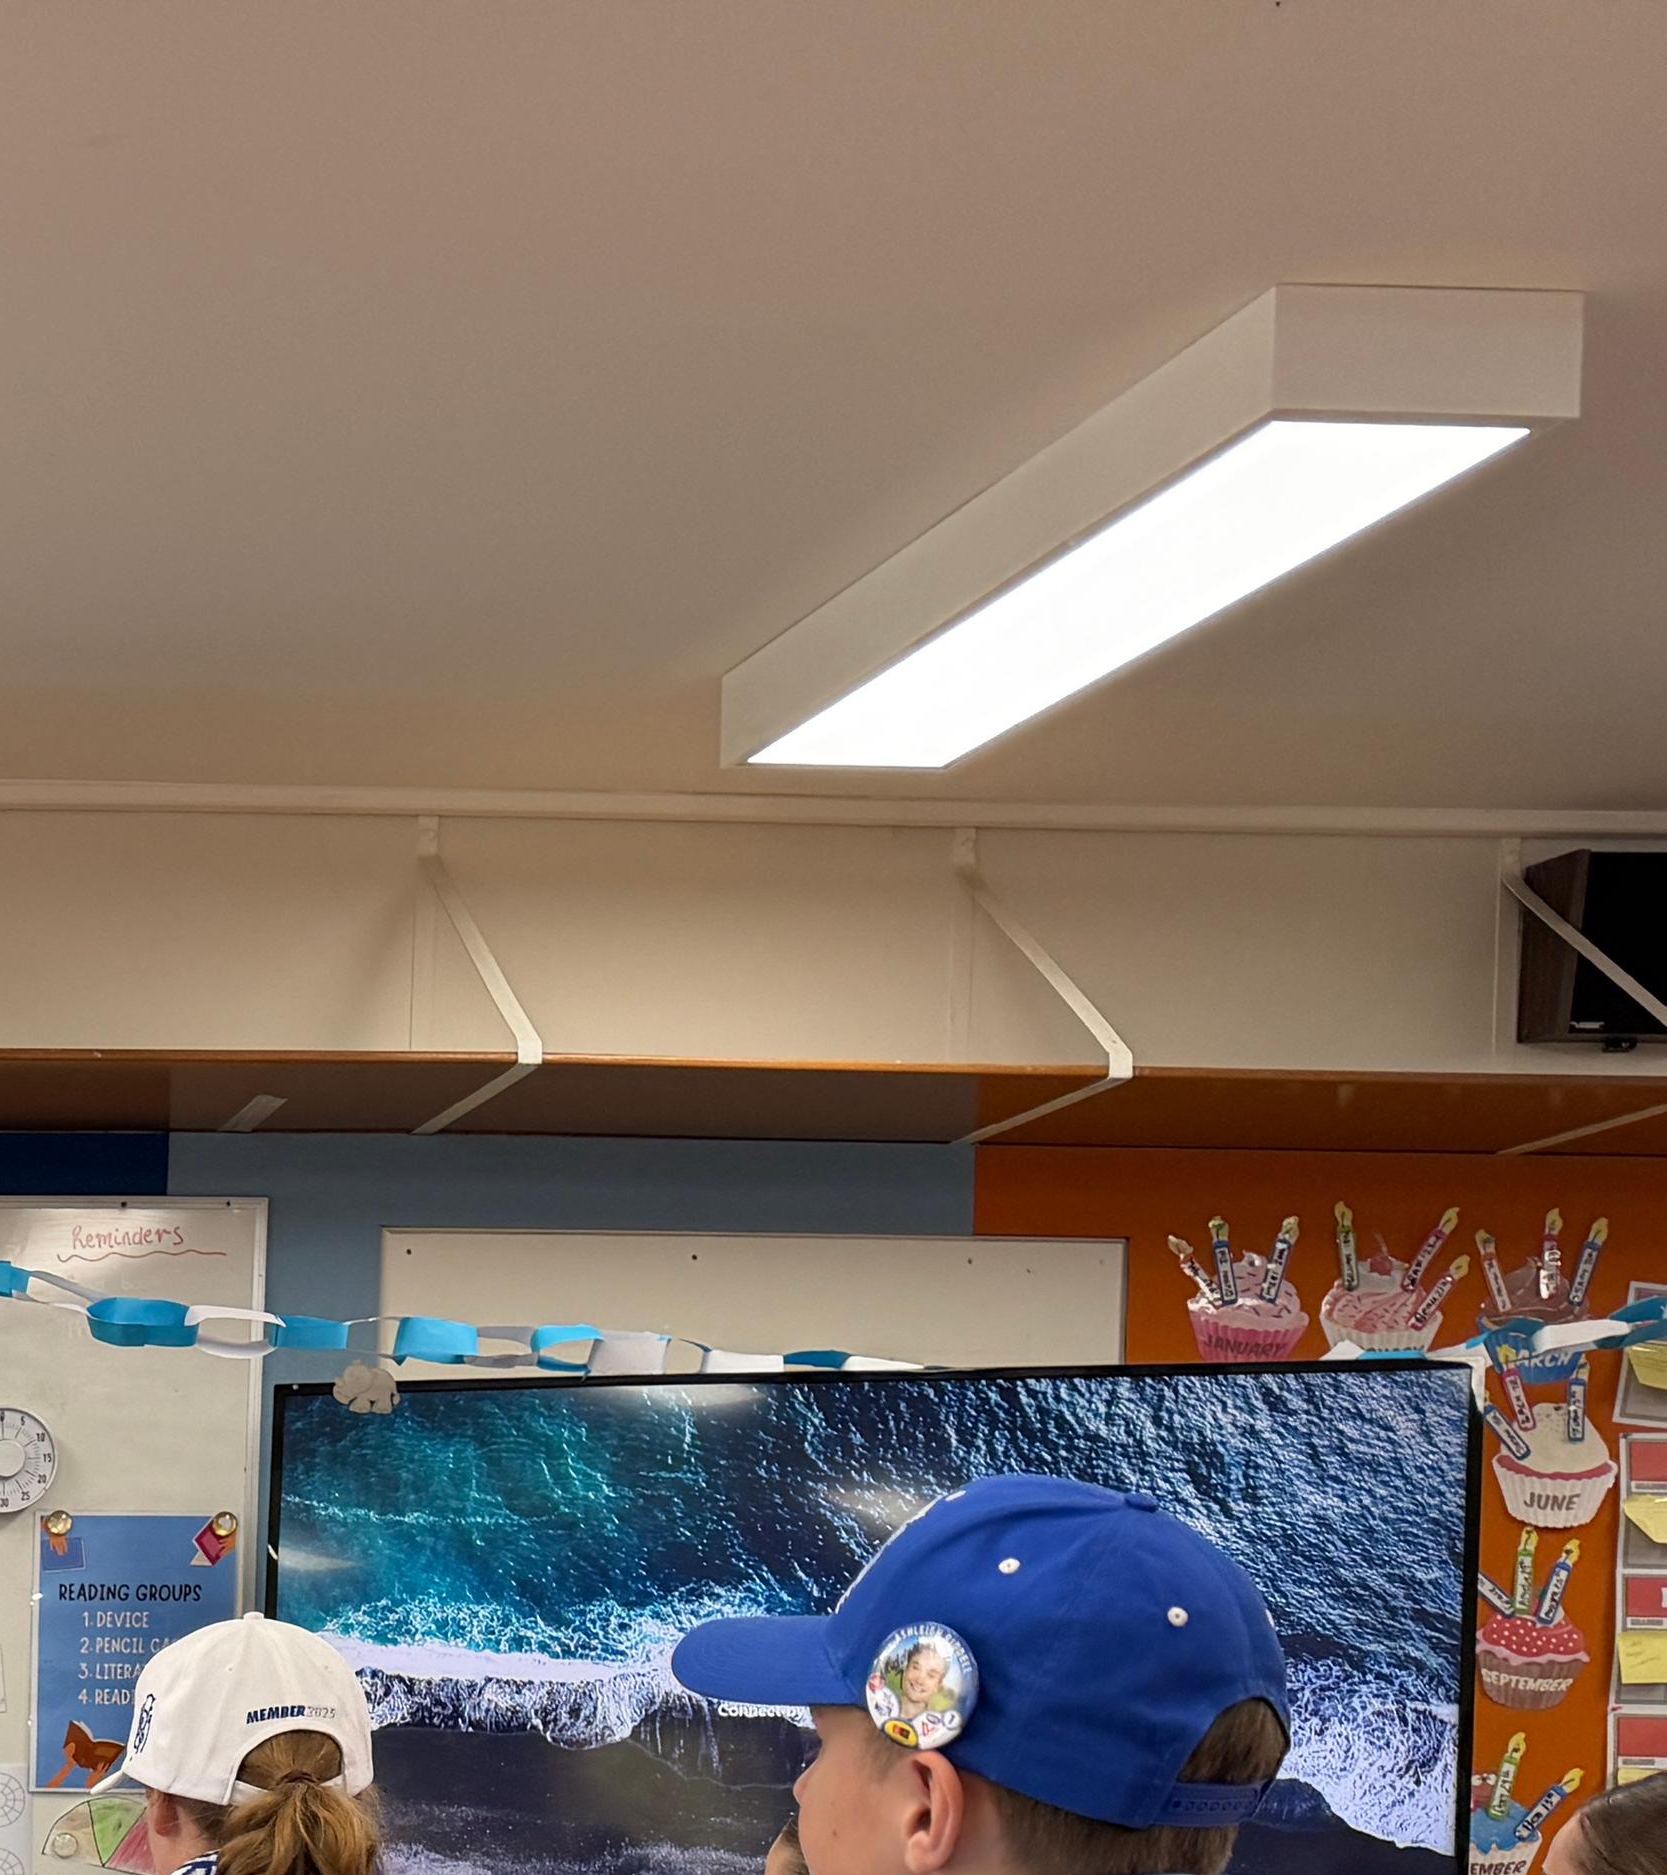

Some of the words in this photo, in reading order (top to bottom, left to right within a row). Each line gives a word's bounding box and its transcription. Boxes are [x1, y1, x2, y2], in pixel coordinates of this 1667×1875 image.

[72, 1225, 185, 1249] Reminders
[1203, 1336, 1287, 1356] JANUARY
[1515, 1351, 1571, 1368] ARCH
[1524, 1492, 1580, 1510] JUNE
[59, 1583, 129, 1602] READING
[136, 1584, 202, 1602] GROUPS
[97, 1612, 149, 1628] DEVICE
[96, 1638, 144, 1653] PENCIL
[1481, 1668, 1573, 1692] SEPTEMBER
[246, 1705, 306, 1724] MEMBER
